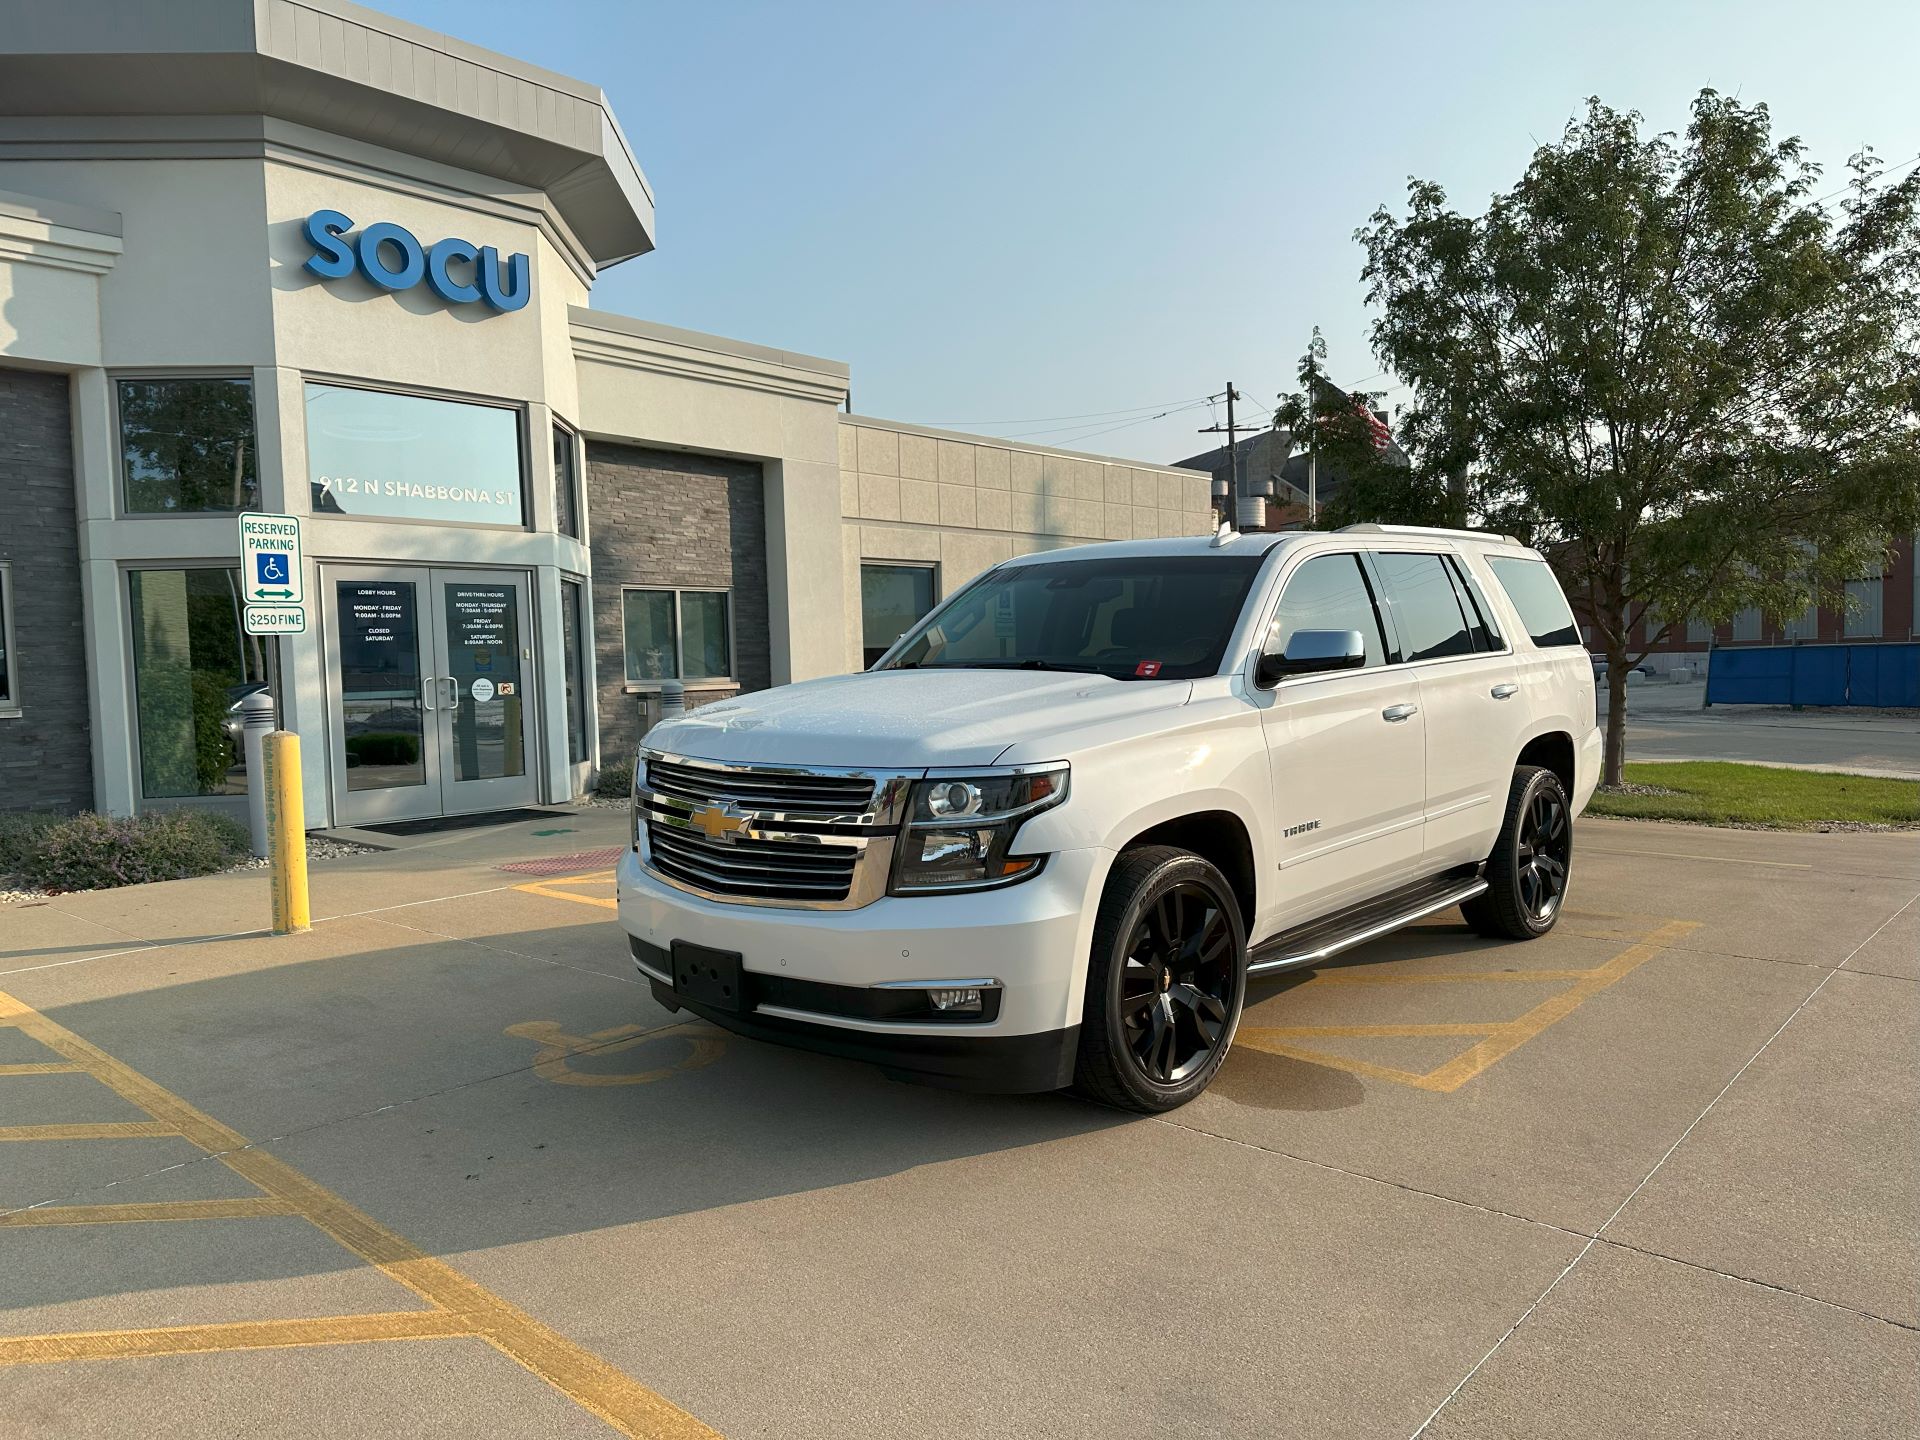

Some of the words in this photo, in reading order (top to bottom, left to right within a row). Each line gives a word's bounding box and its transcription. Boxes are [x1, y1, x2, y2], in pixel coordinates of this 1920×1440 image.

[302, 209, 530, 314] SOCU
[319, 476, 358, 493] 912
[364, 480, 378, 495] N
[384, 481, 491, 504] SHABBONA
[495, 491, 513, 505] ST
[245, 522, 296, 535] RESERVED
[249, 538, 294, 550] PARKING
[250, 614, 276, 626] $250
[279, 615, 302, 625] FINE
[1283, 819, 1321, 838] TAHOE
